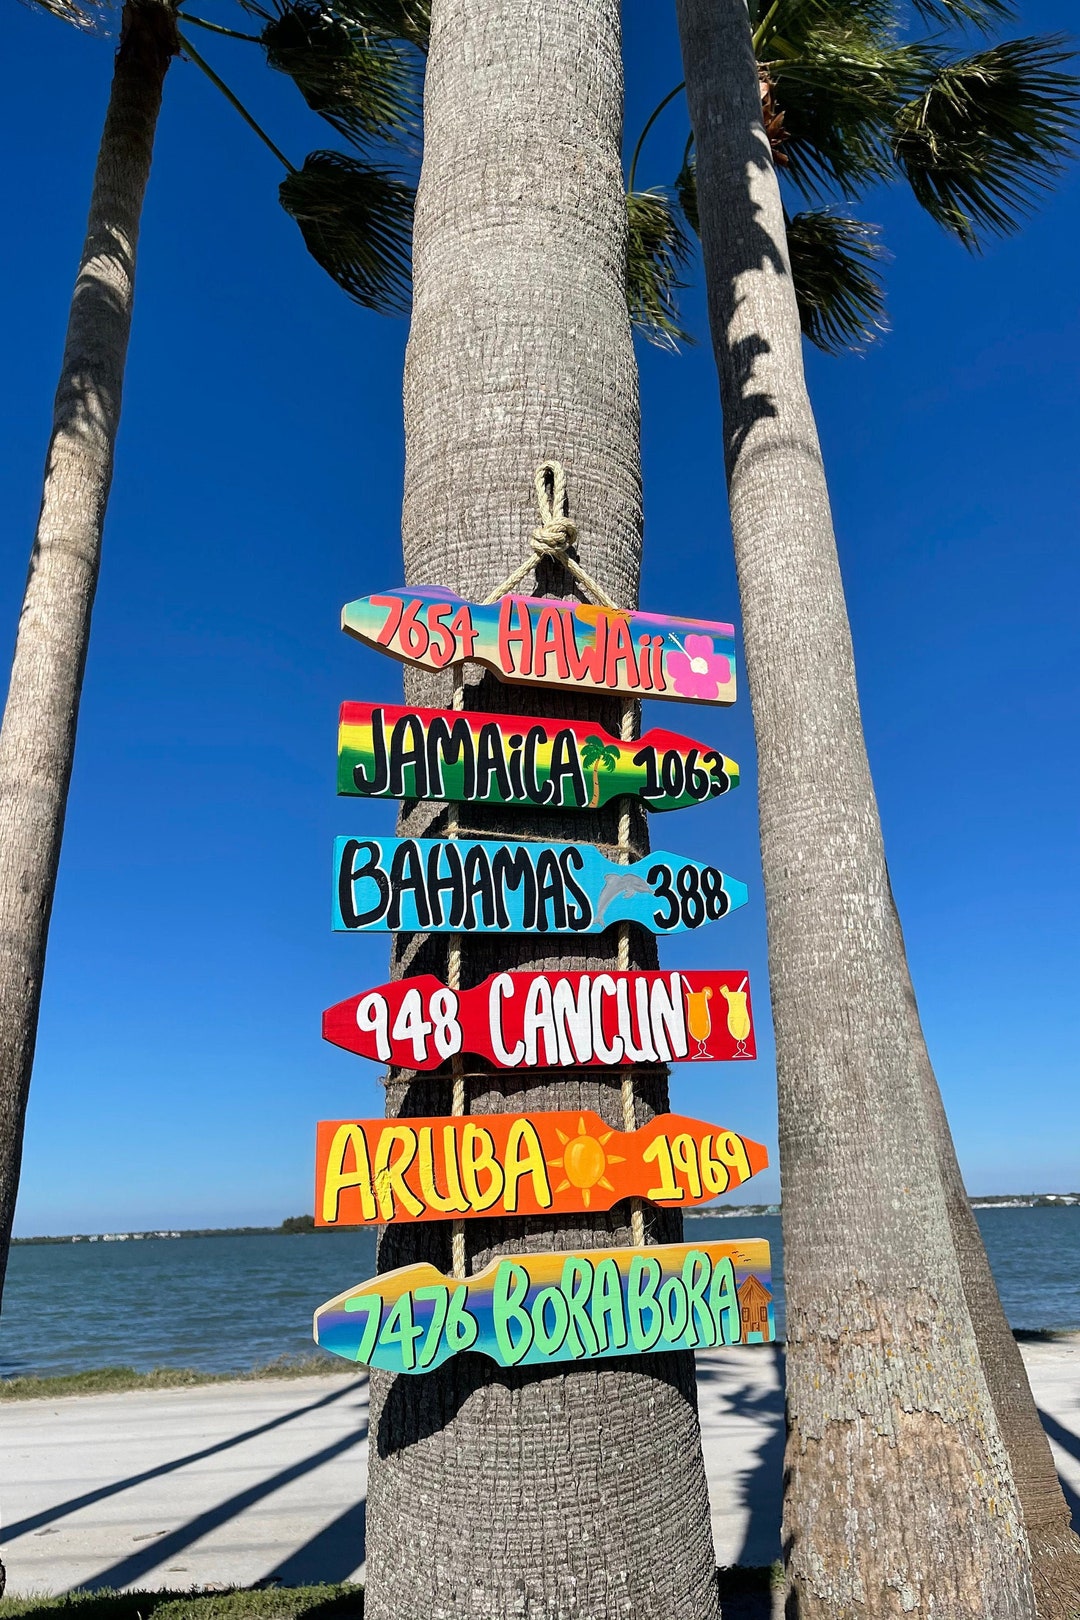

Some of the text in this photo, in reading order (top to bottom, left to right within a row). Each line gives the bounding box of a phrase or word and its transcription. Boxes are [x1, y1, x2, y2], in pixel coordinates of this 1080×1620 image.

[369, 595, 479, 667] 7654
[633, 746, 731, 800] 1063
[338, 839, 731, 932] BAHAMAS 388
[357, 972, 689, 1067] 948 CANCUN
[322, 1118, 753, 1223] ARUBA 1969
[345, 1286, 480, 1370] 7476
